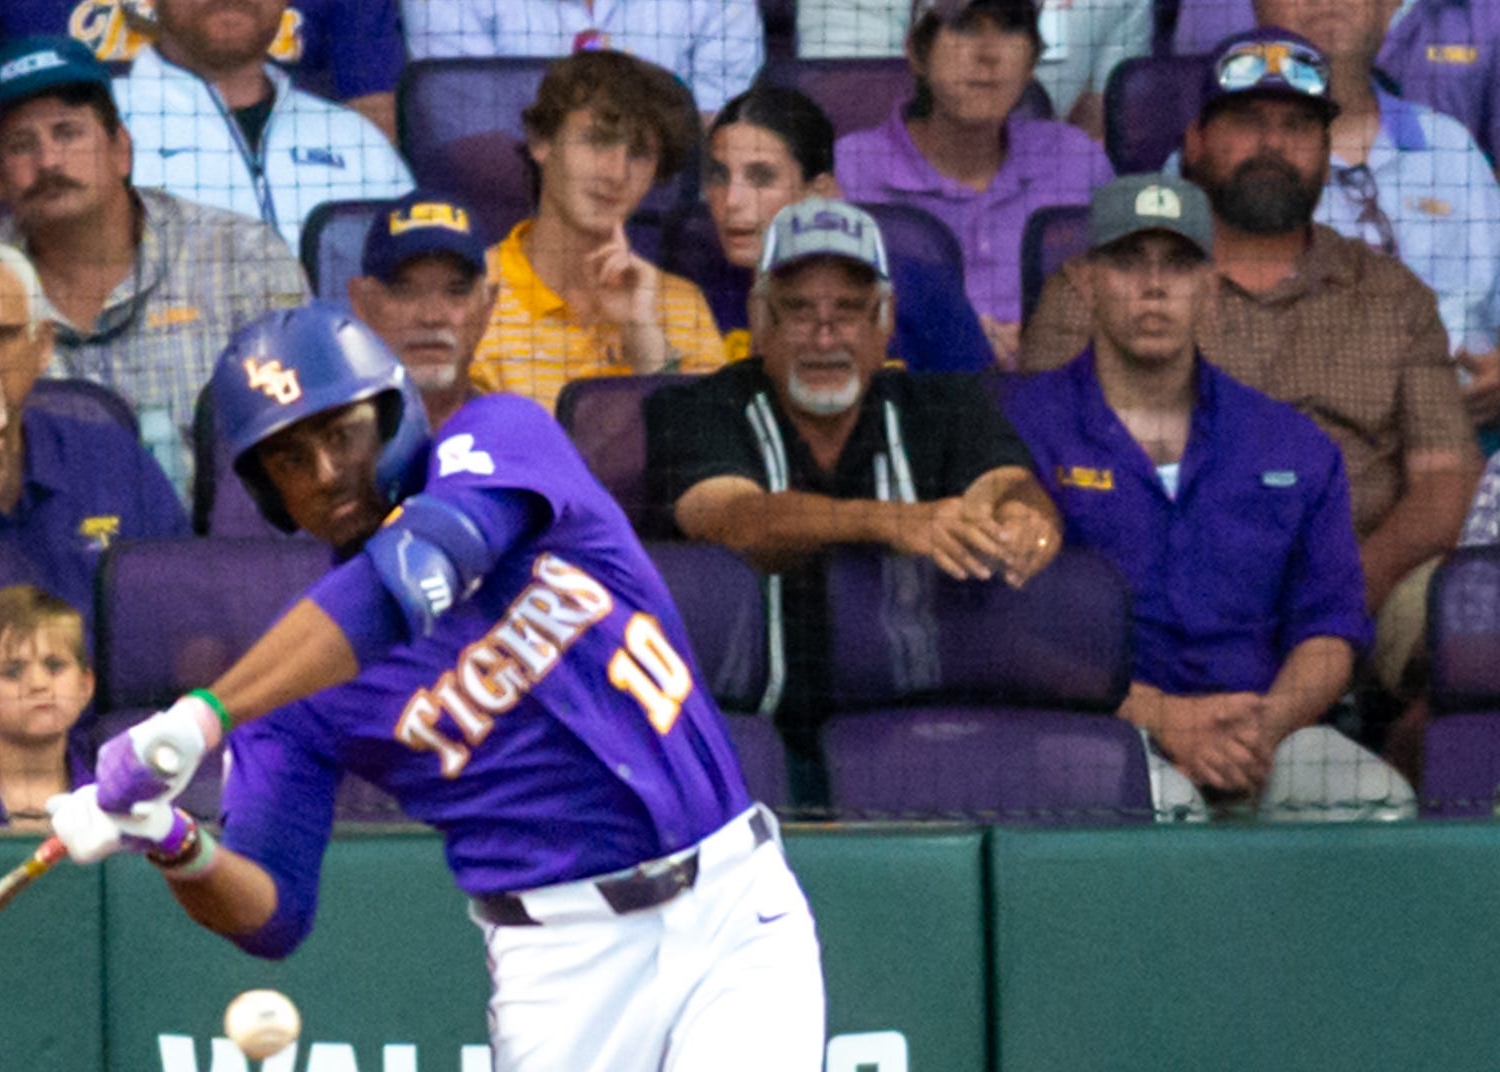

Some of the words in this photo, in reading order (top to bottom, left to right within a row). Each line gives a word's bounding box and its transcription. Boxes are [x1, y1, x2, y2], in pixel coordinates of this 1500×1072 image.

[389, 202, 471, 235] LSU
[791, 210, 863, 239] LSU
[243, 358, 302, 405] LSU
[395, 552, 613, 779] TIGERS
[608, 611, 694, 736] 10
